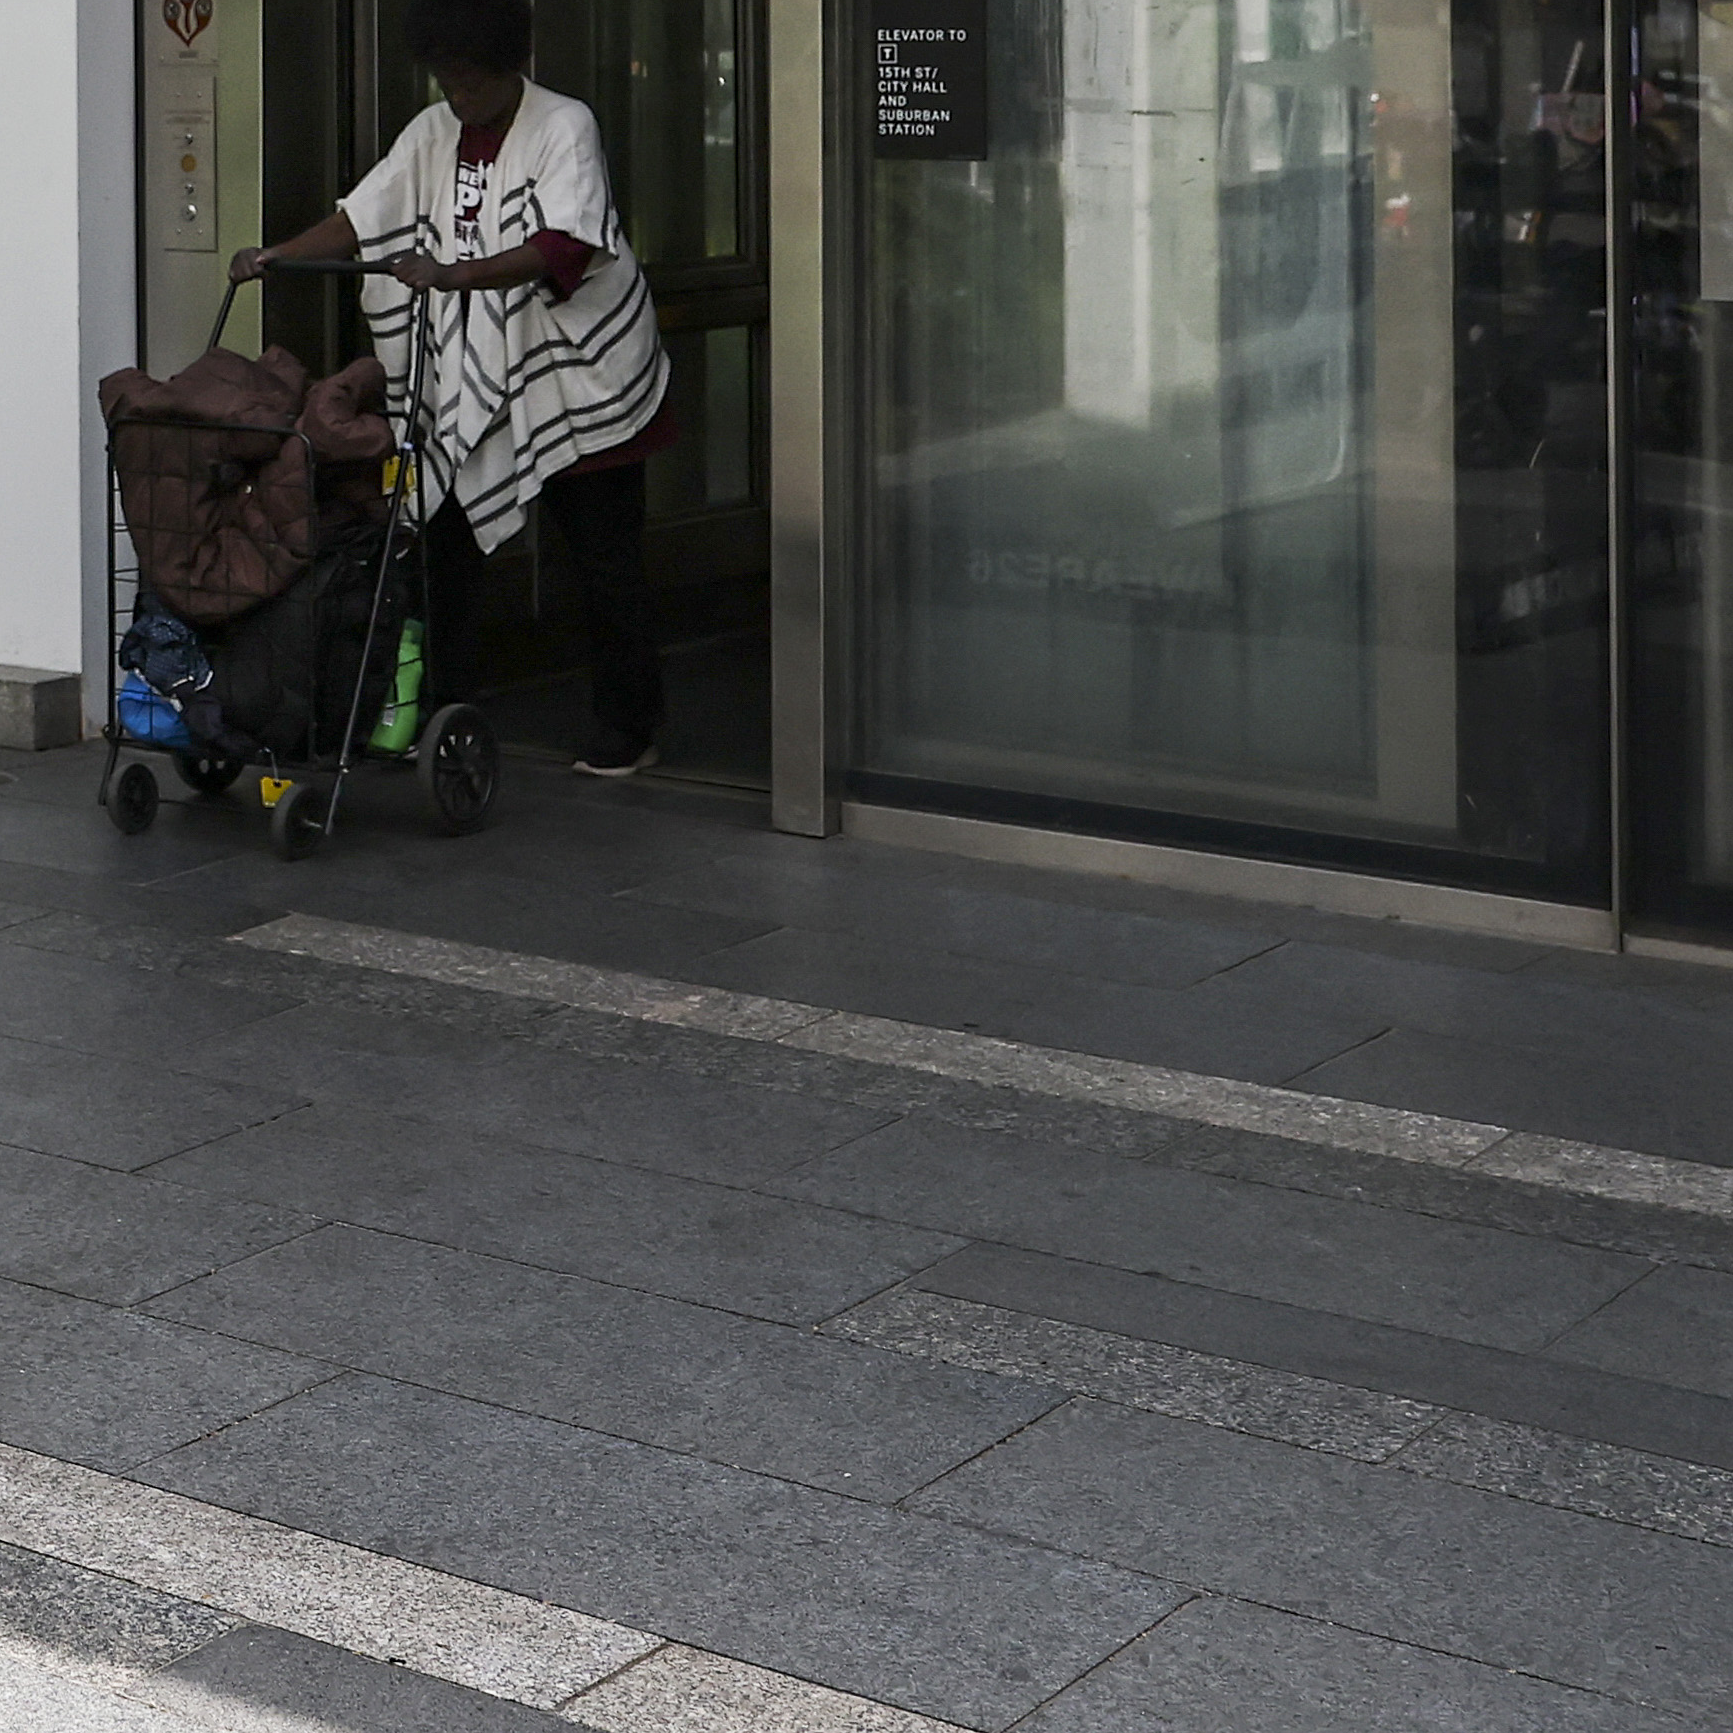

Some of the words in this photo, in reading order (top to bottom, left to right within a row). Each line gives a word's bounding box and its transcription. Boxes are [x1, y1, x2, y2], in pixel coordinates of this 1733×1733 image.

[877, 29, 945, 41] ELEVATOR
[949, 29, 967, 41] TO
[883, 48, 892, 60] T
[878, 66, 911, 79] 15TH
[914, 67, 939, 79] ST/
[878, 80, 908, 93] CITY
[912, 81, 948, 93] HALL
[878, 95, 908, 107] AND
[878, 109, 951, 122] SUBURBAN
[878, 123, 935, 136] STATION
